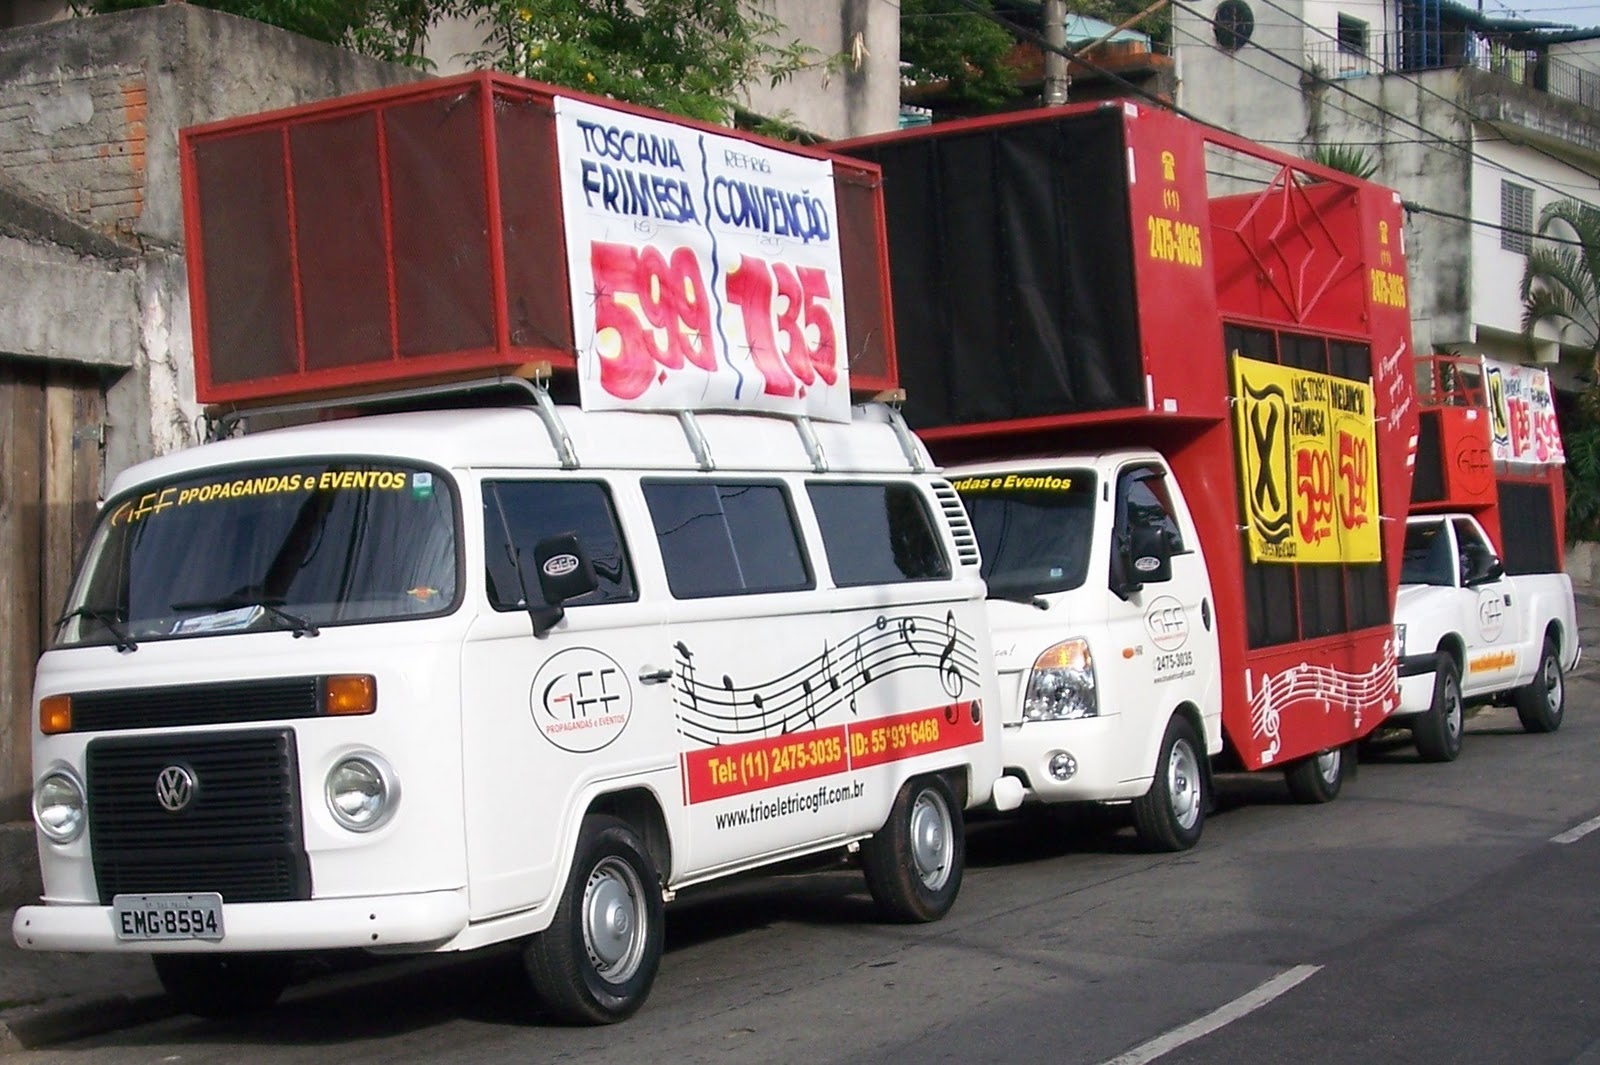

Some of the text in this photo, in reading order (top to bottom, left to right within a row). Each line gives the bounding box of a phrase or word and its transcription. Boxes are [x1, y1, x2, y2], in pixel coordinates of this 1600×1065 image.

[576, 118, 685, 172] TOSCANA
[580, 158, 702, 226] FRIMESA
[712, 174, 831, 244] CONVENÇÃO
[1148, 214, 1203, 267] 2475-3035
[304, 477, 313, 489] e
[319, 471, 406, 489] EVENTOS
[991, 477, 1002, 488] e
[1003, 475, 1072, 489] Eventos
[546, 718, 593, 734] PROPAGANDAS
[598, 714, 626, 726] EVENTOS
[708, 755, 738, 785] Tel:
[740, 750, 769, 786] (11)
[772, 736, 841, 774] 2475-3035
[850, 731, 869, 757] ID:
[715, 779, 865, 830] www.trioeletricogff.com.br
